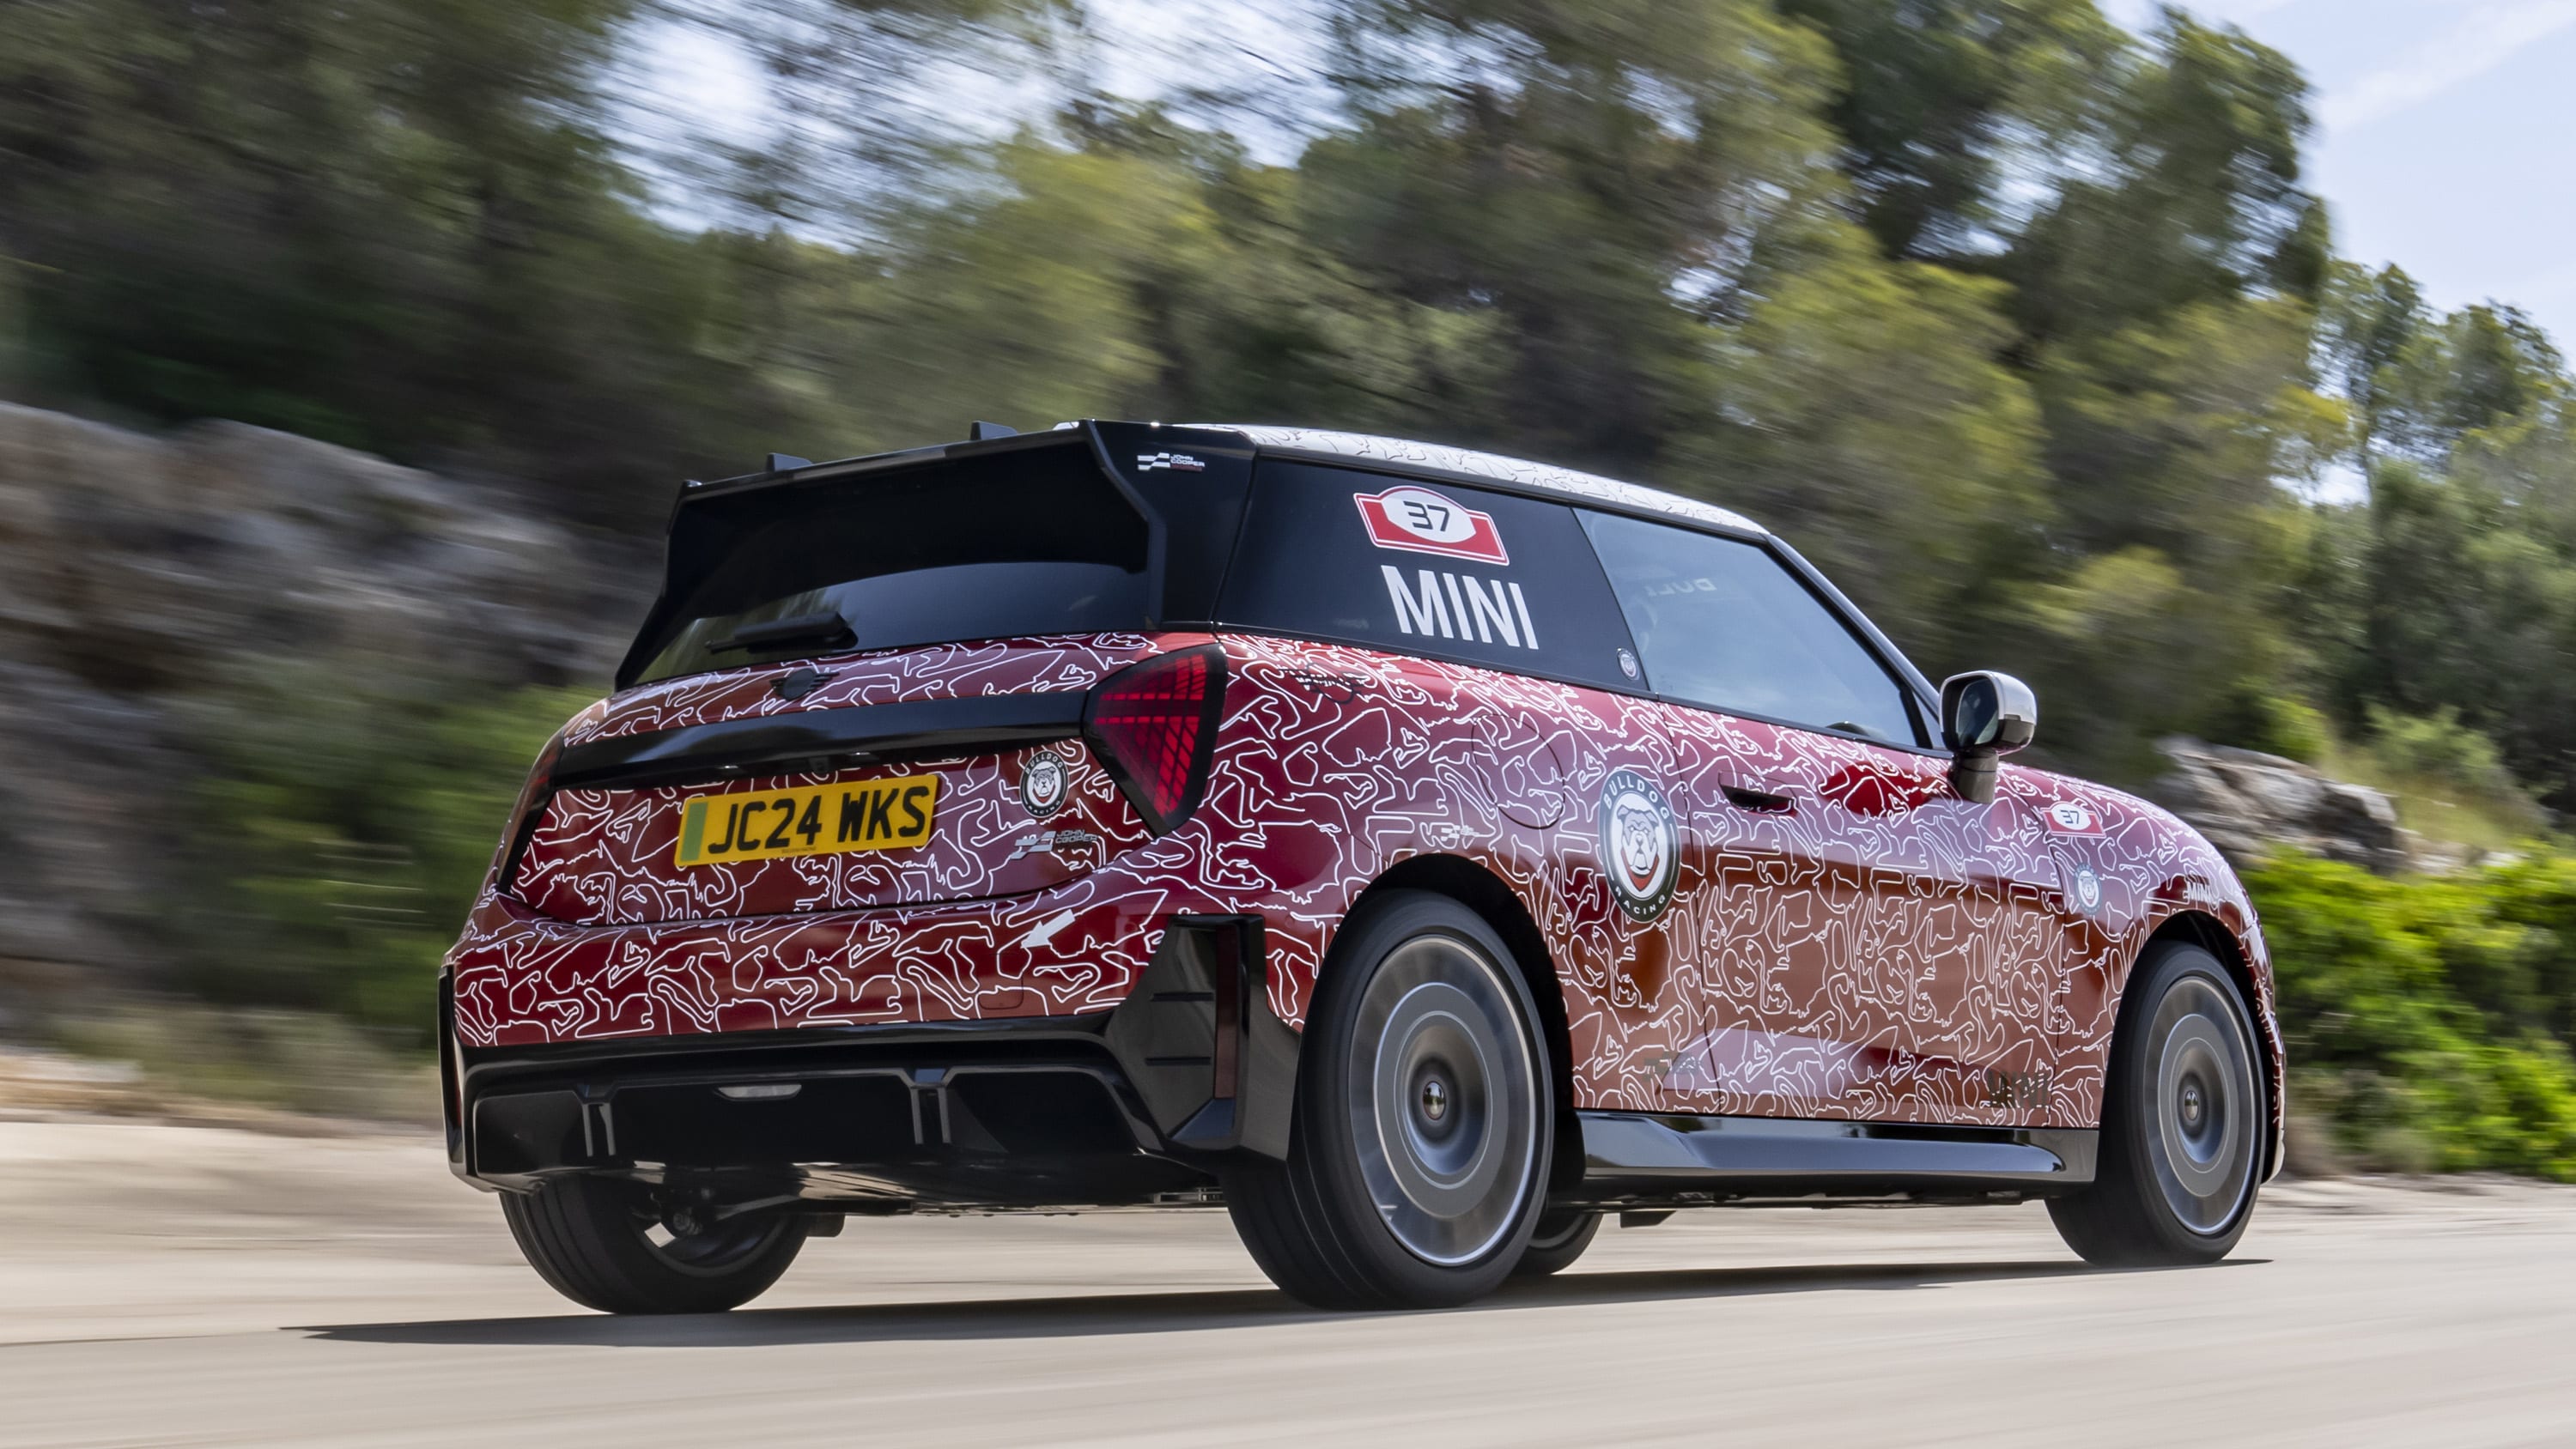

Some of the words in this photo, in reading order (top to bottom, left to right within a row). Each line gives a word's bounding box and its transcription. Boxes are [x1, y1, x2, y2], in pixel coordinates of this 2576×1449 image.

[1170, 458, 1206, 468] COOPER
[1403, 500, 1450, 532] 37
[1381, 565, 1539, 650] MINI
[1025, 753, 1063, 774] BULLDOG
[1603, 775, 1670, 819] BULLDOG
[708, 795, 823, 854] JC24
[837, 785, 930, 843] WKS
[2060, 809, 2080, 825] 37
[1055, 834, 1097, 843] COOPER
[1056, 829, 1084, 838] JOHN
[1615, 886, 1666, 915] RACING
